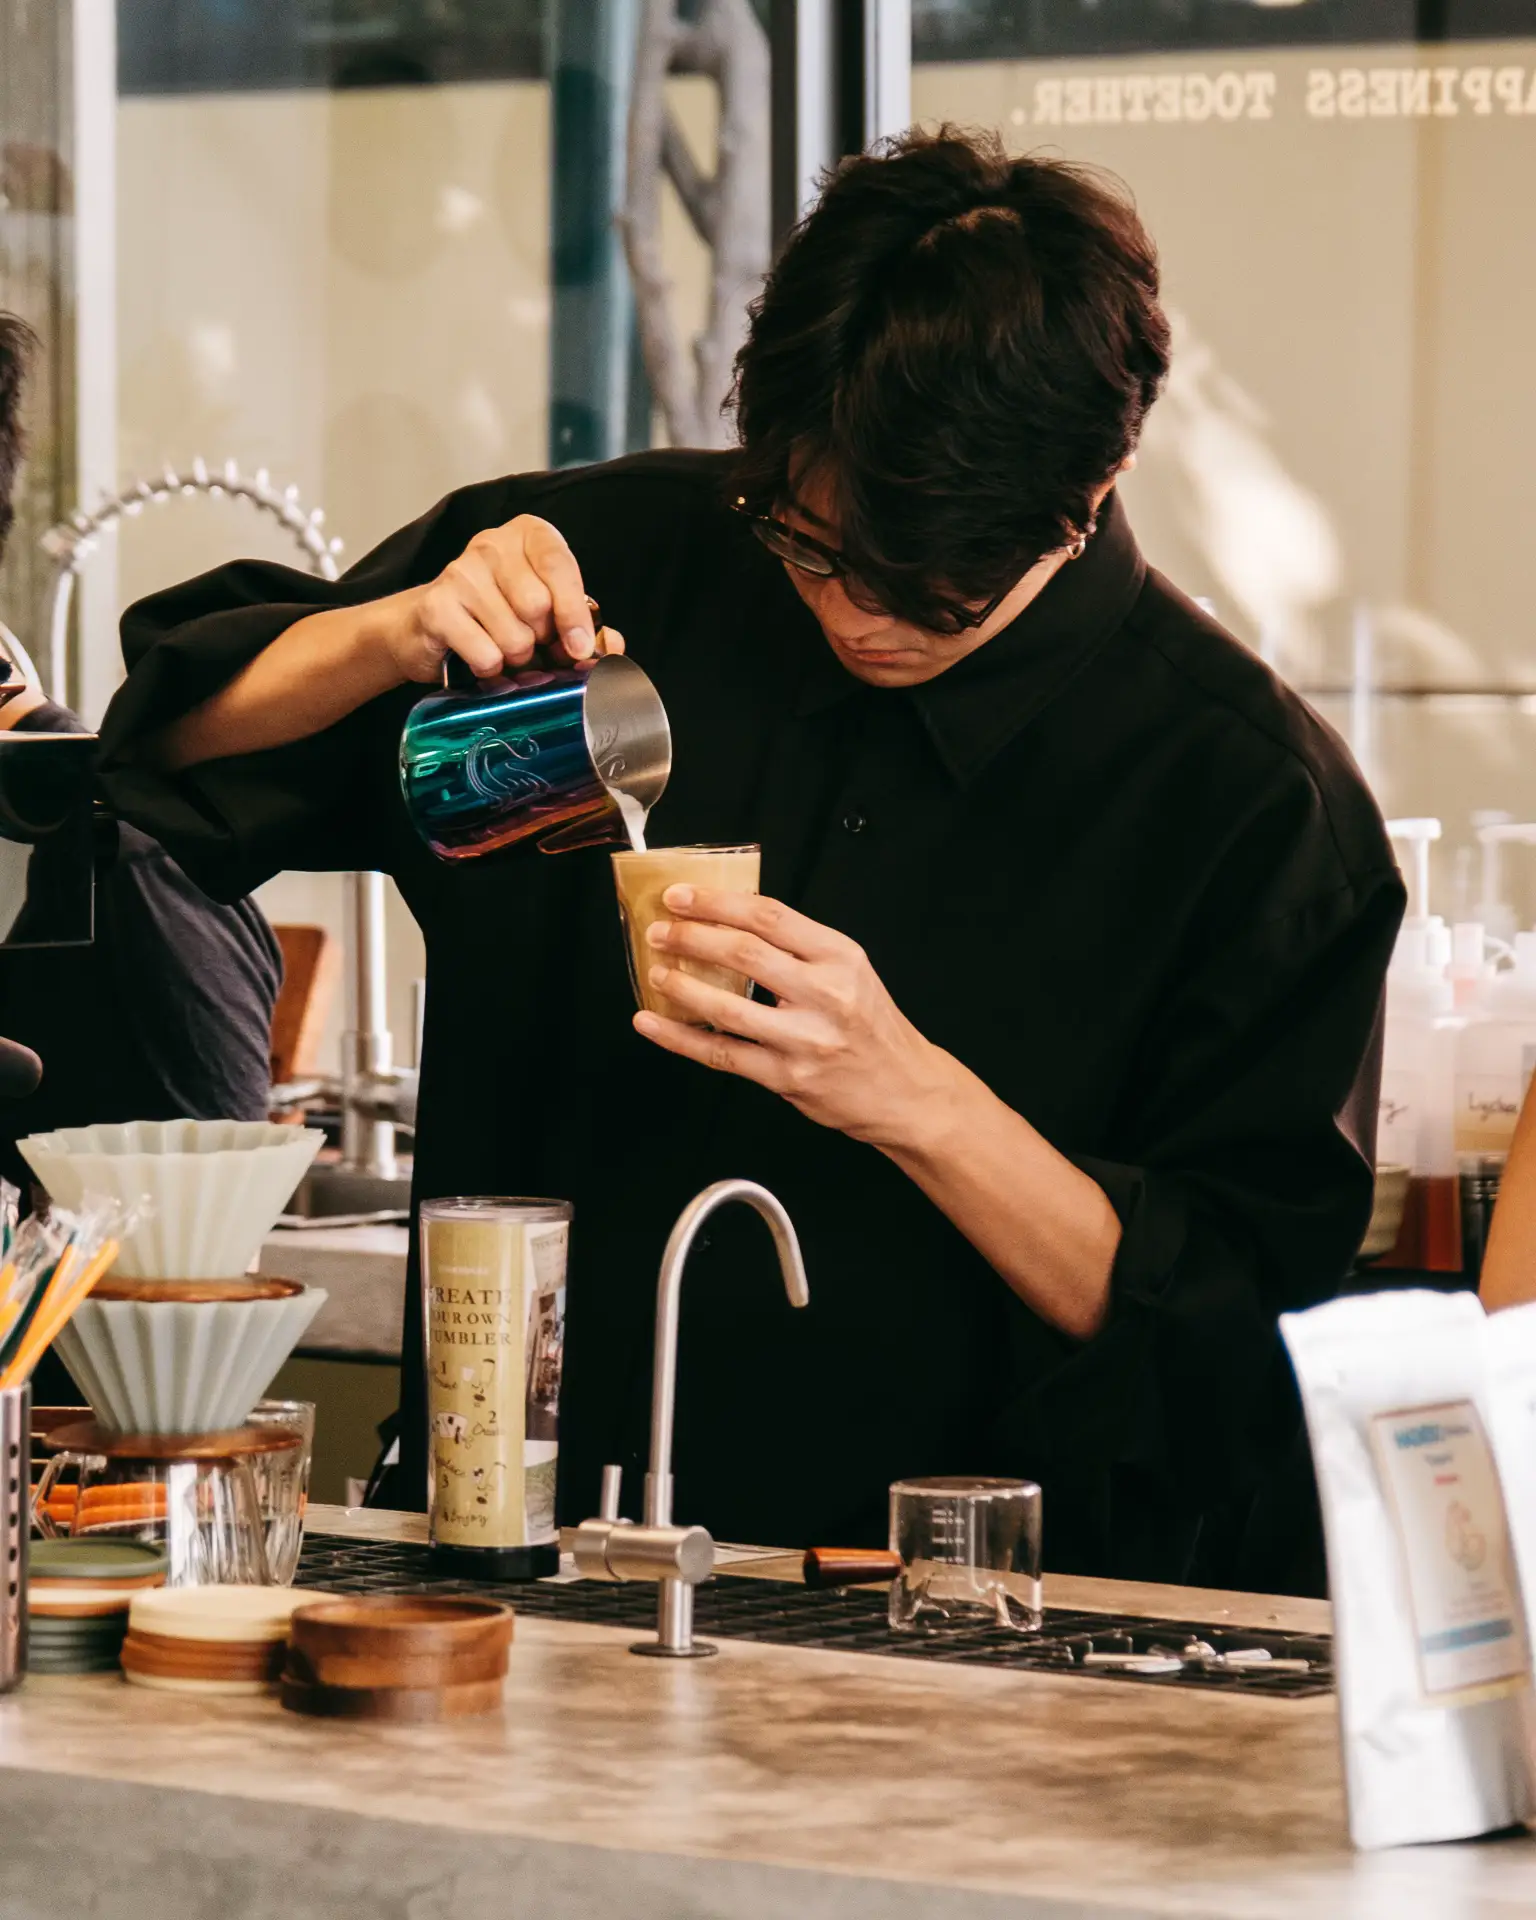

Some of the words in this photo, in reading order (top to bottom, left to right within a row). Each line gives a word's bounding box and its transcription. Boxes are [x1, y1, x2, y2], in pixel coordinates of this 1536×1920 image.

[430, 1286, 512, 1305] REATE
[430, 1328, 513, 1346] UMBLER
[488, 1410, 497, 1424] 2
